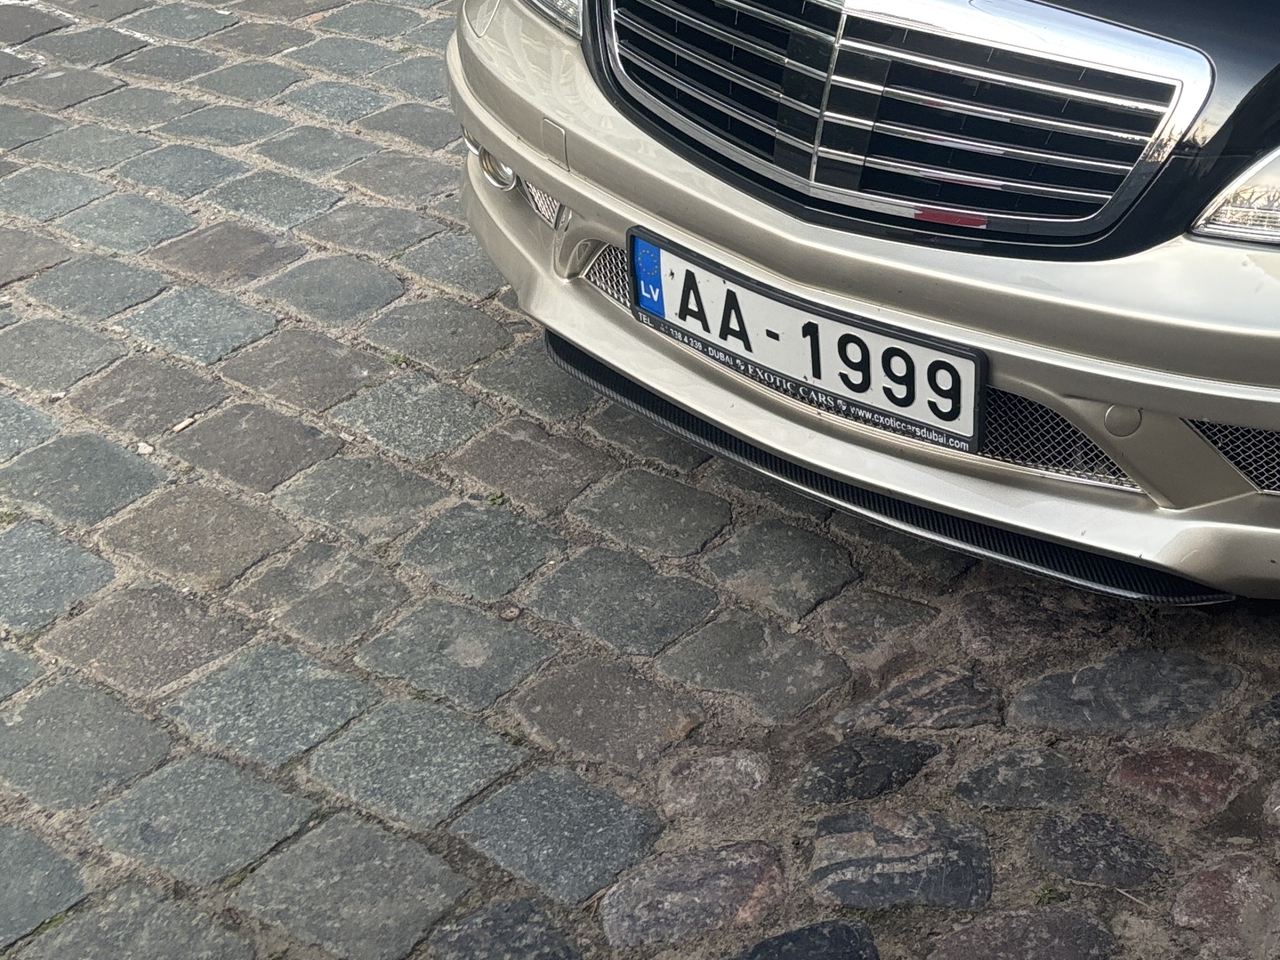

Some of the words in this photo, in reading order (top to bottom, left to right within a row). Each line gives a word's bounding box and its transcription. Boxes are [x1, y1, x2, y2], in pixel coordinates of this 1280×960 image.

[640, 280, 659, 302] LV
[747, 364, 796, 393] EXOTIC
[799, 386, 835, 407] CARS
